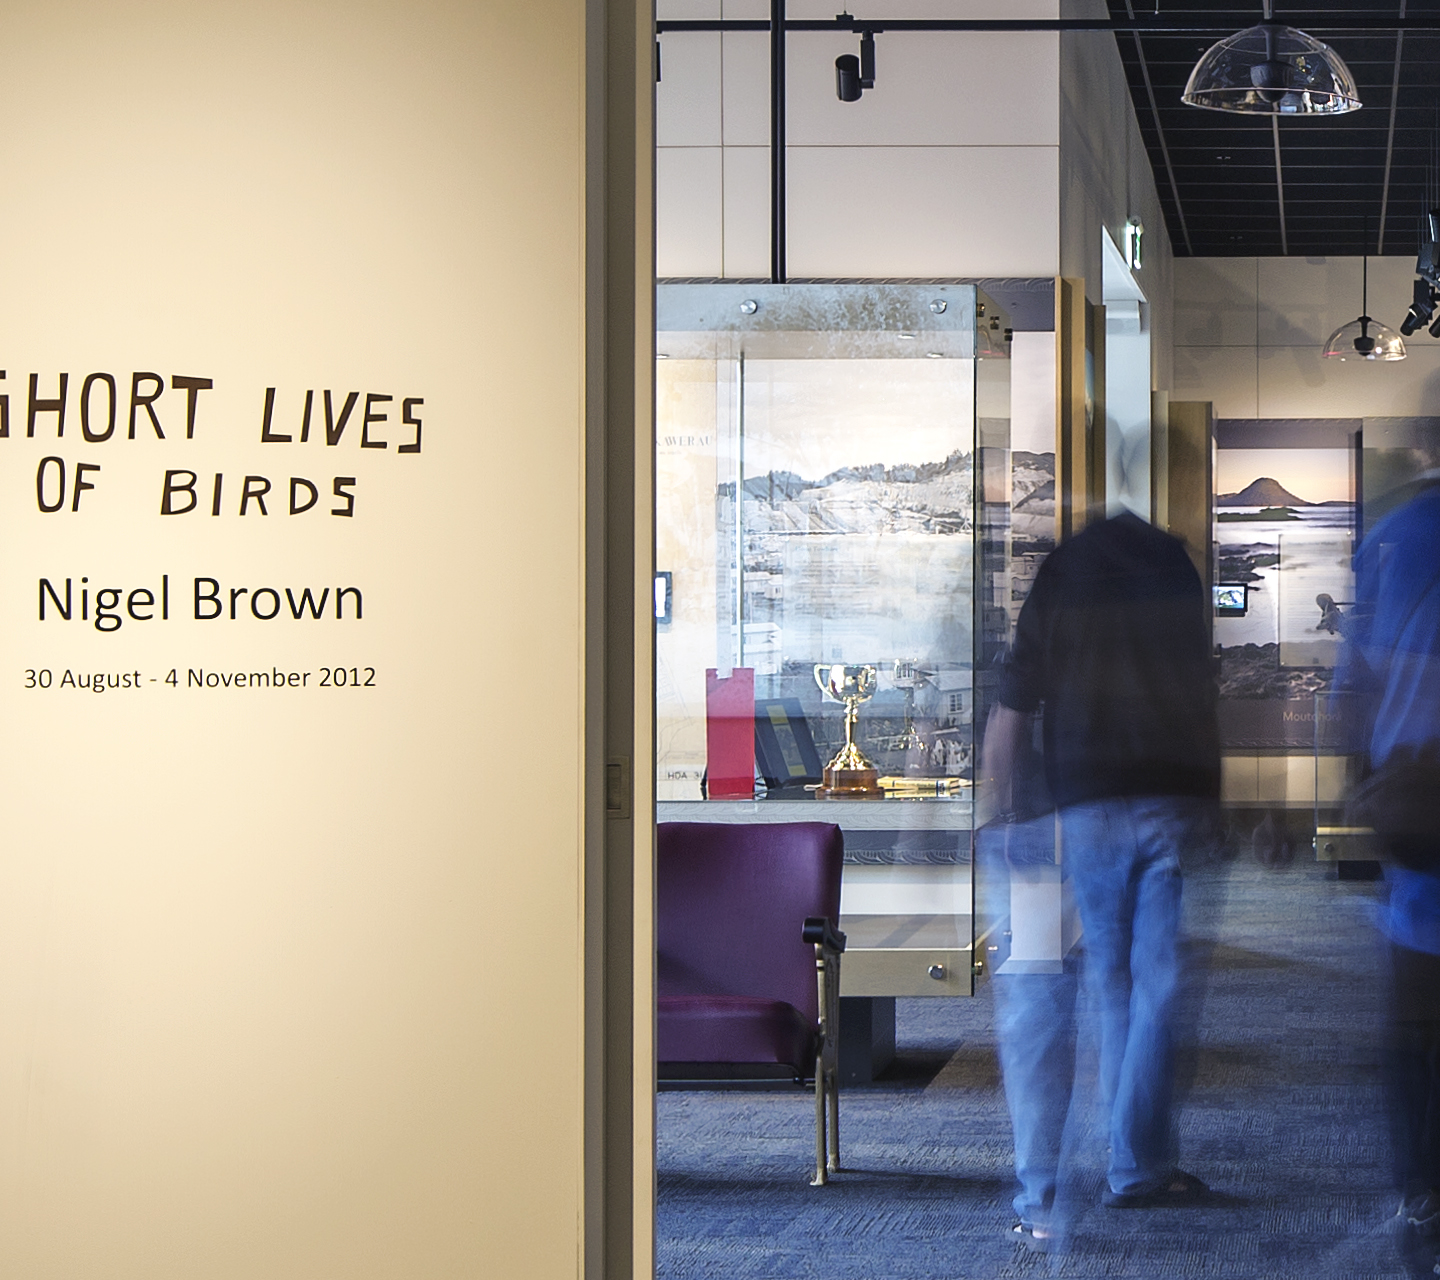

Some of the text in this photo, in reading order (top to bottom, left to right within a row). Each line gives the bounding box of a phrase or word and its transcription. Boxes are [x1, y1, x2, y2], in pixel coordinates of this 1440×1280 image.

[260, 386, 425, 454] LIVES
[36, 455, 357, 518] OF BIRDS
[38, 573, 364, 632] Nigel Brown
[23, 667, 53, 689] 30
[60, 667, 142, 693] August
[164, 667, 180, 688] 4
[187, 666, 311, 689] November
[318, 666, 377, 688] 2012
